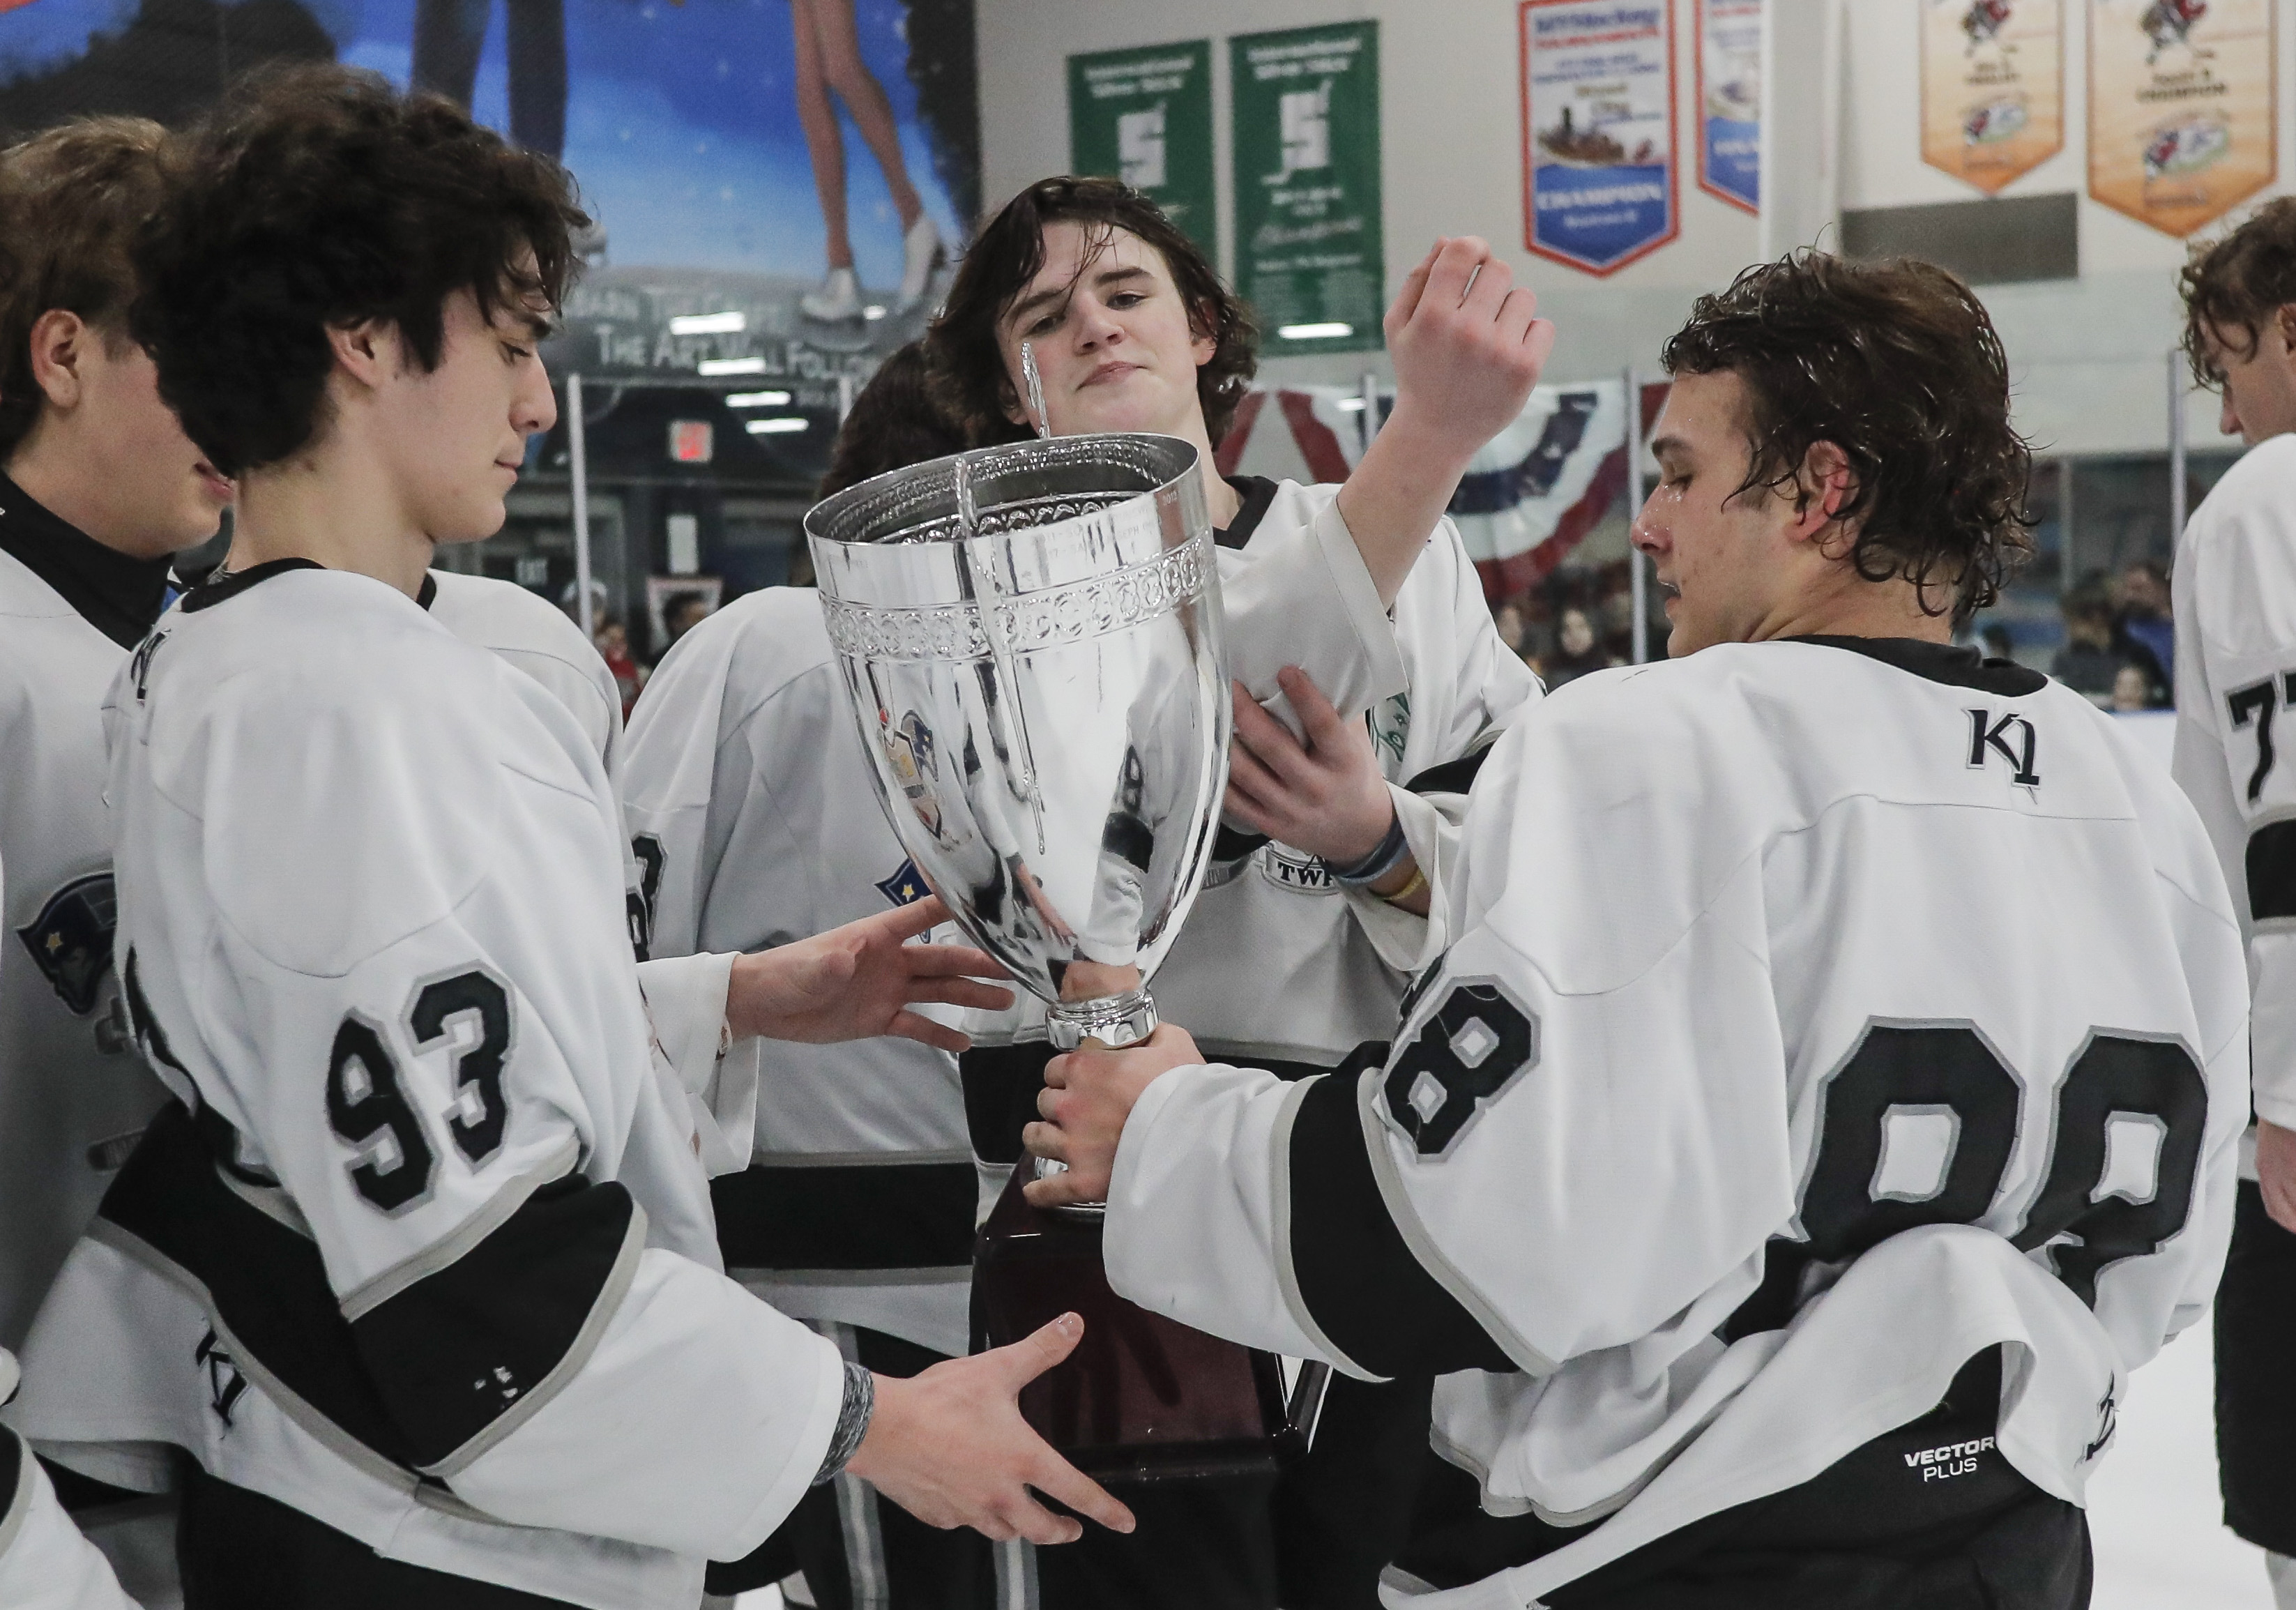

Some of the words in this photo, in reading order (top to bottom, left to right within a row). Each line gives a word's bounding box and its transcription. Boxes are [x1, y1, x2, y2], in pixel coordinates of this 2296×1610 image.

[2223, 667, 2296, 809] 7
[326, 959, 518, 1218] 93
[1382, 948, 1542, 1164] 8
[1904, 1436, 1995, 1467] VECTOR
[1923, 1457, 1977, 1482] PLUS
